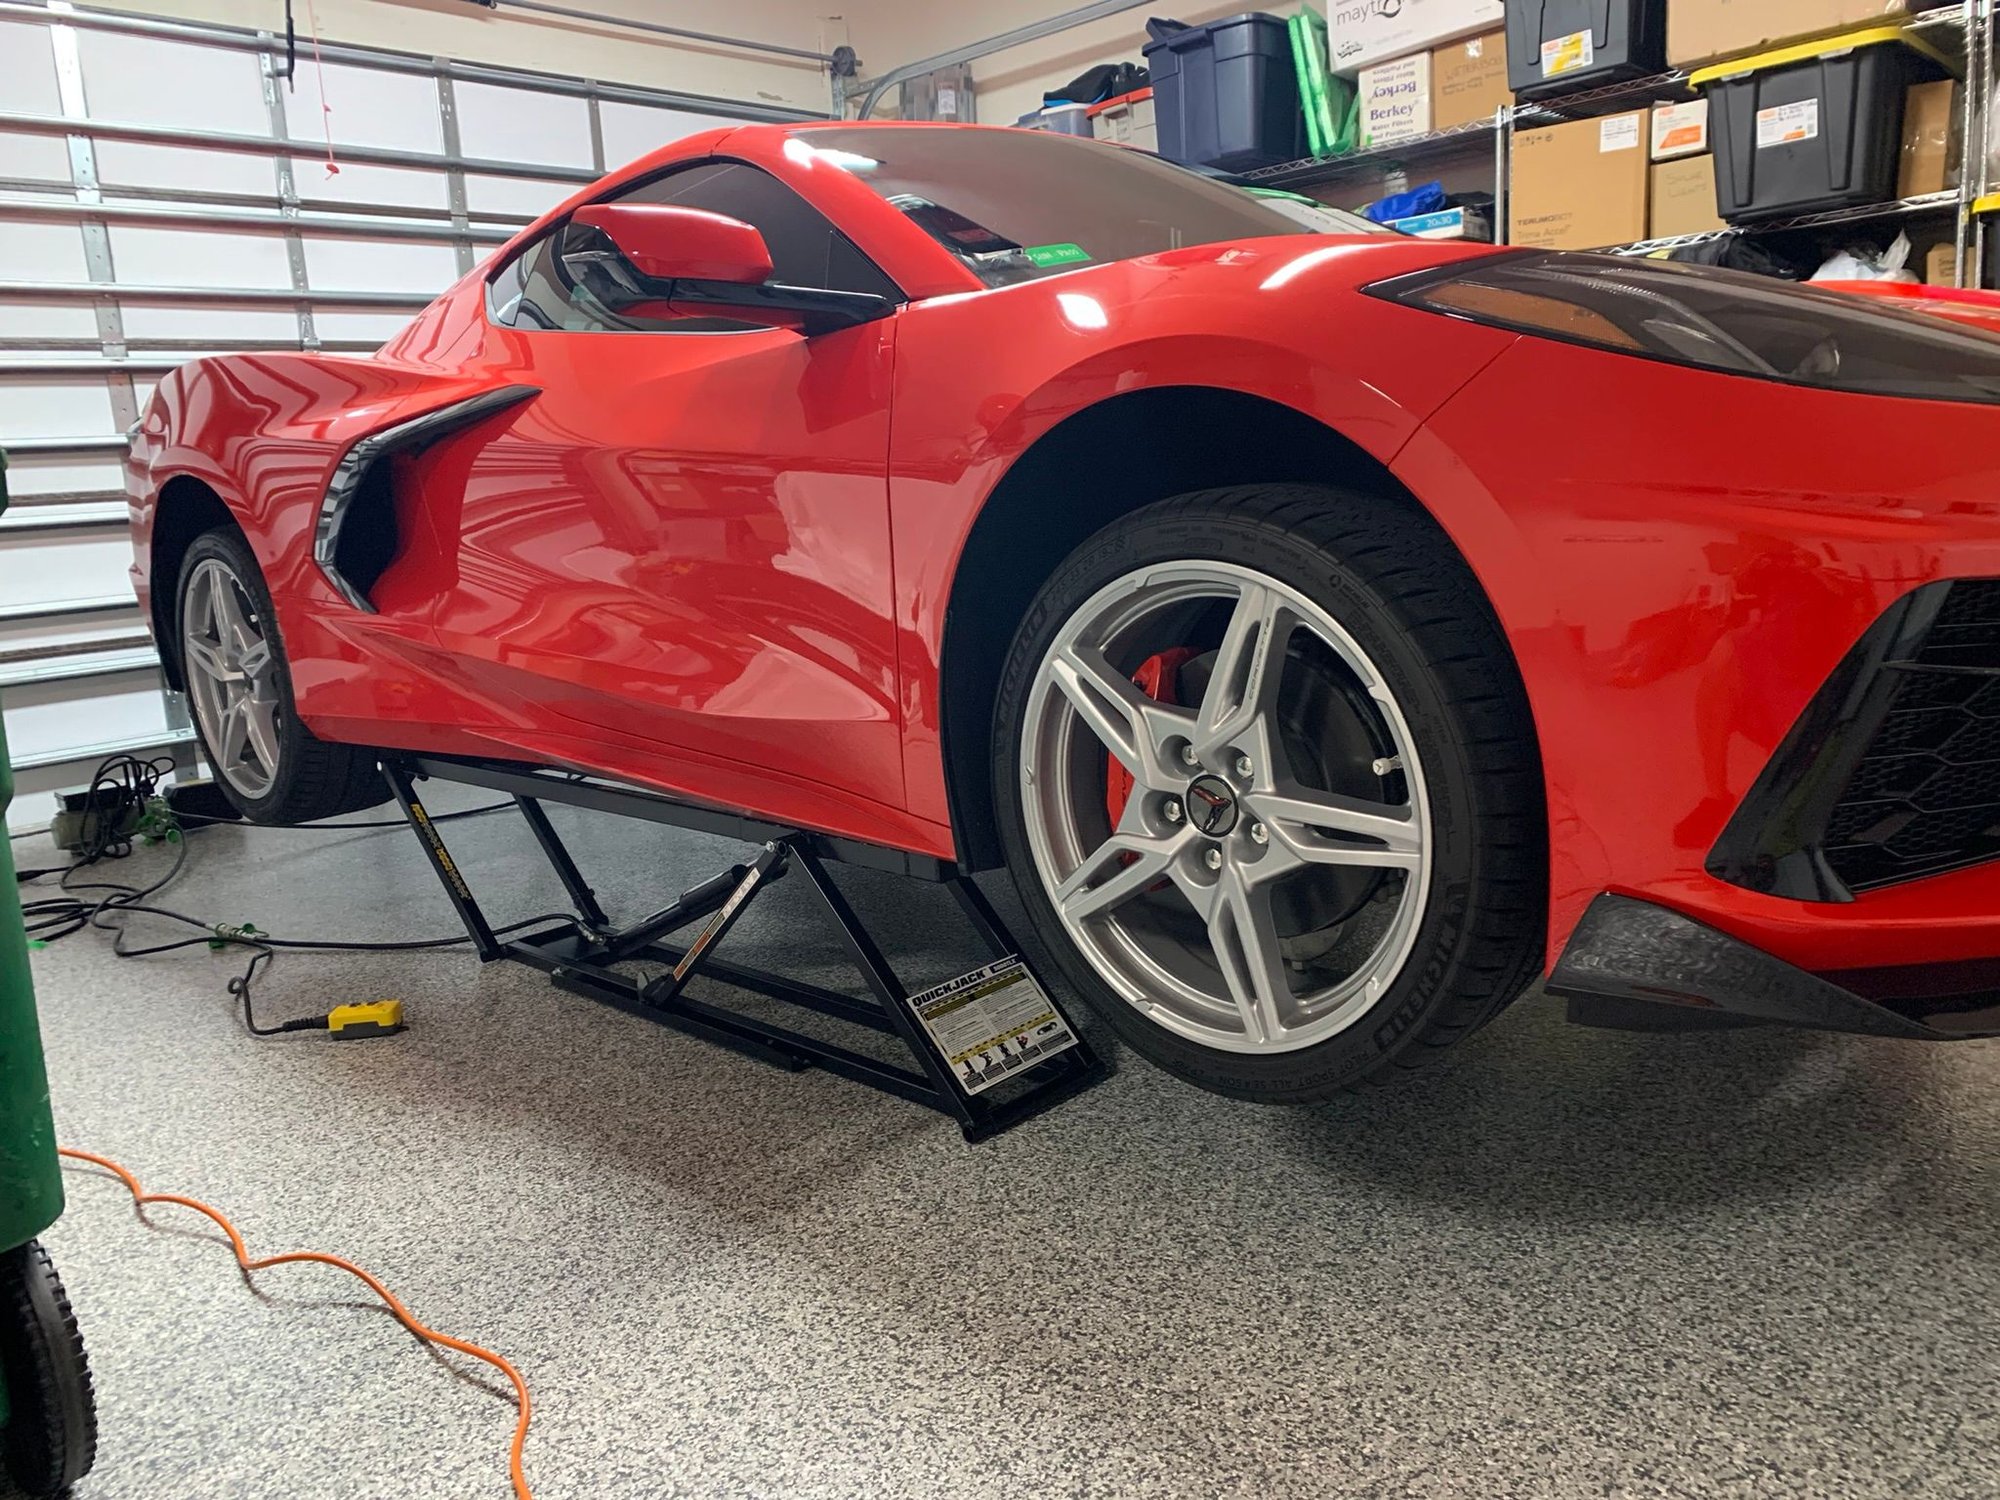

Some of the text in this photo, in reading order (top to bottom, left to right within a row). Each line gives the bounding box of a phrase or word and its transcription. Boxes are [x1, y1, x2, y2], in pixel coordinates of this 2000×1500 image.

[1372, 81, 1416, 98] Berkey
[1370, 104, 1414, 121] Berkey
[911, 969, 986, 1007] QUICKJACK
[1379, 922, 1457, 1048] MICHELIN
